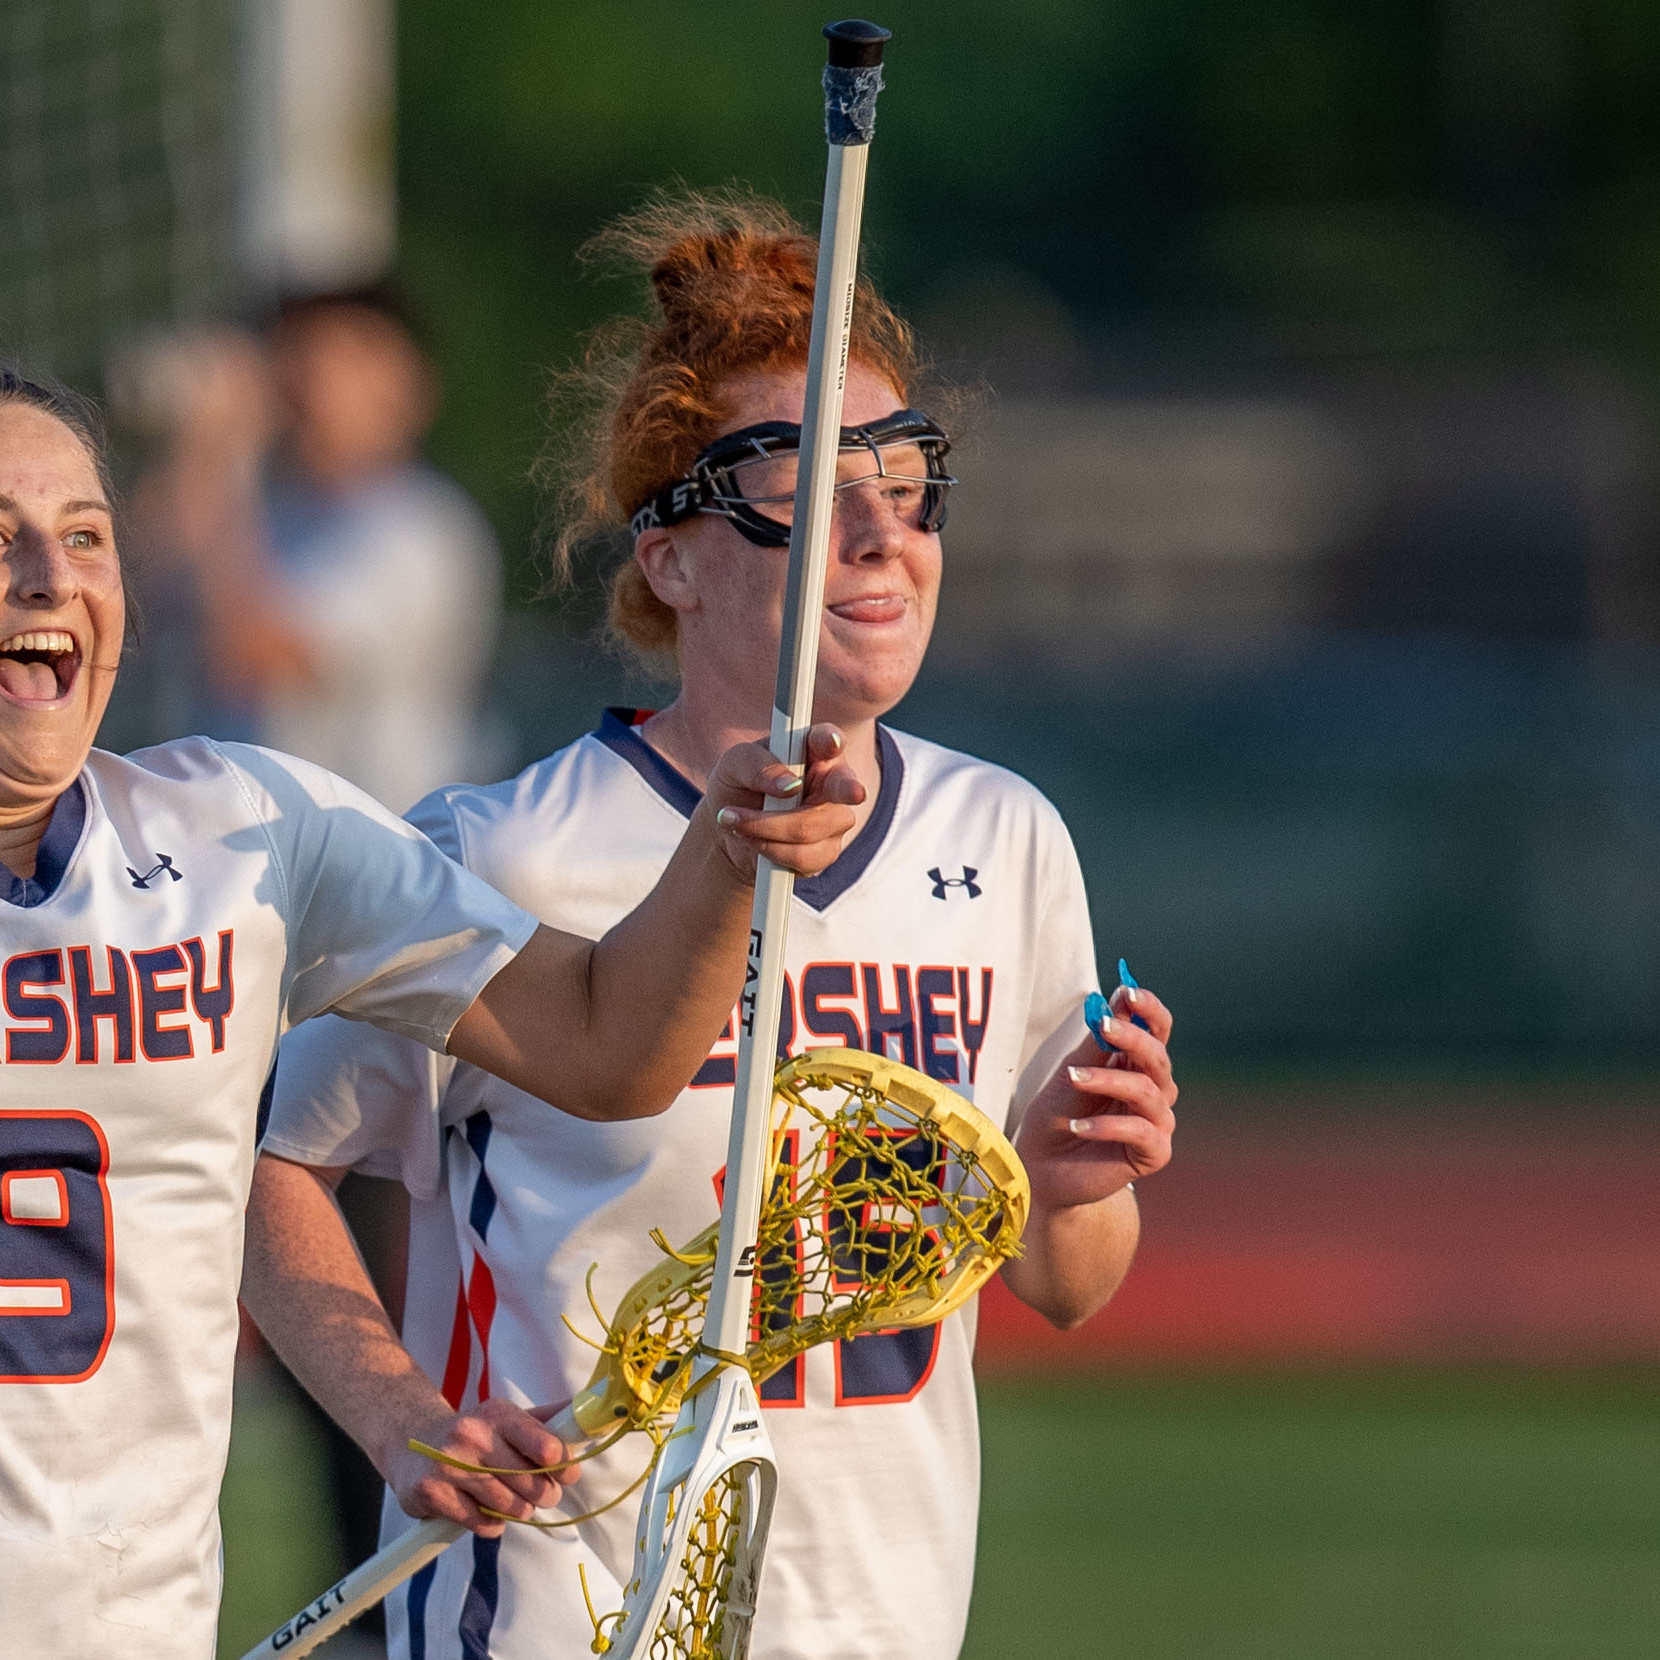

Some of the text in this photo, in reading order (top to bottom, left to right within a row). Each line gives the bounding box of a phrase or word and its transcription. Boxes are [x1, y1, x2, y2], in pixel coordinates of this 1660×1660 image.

[838, 282, 853, 390] MIDSIZE DIAMETER
[688, 961, 994, 1090] SHEY
[271, 1580, 347, 1651] GAIT
